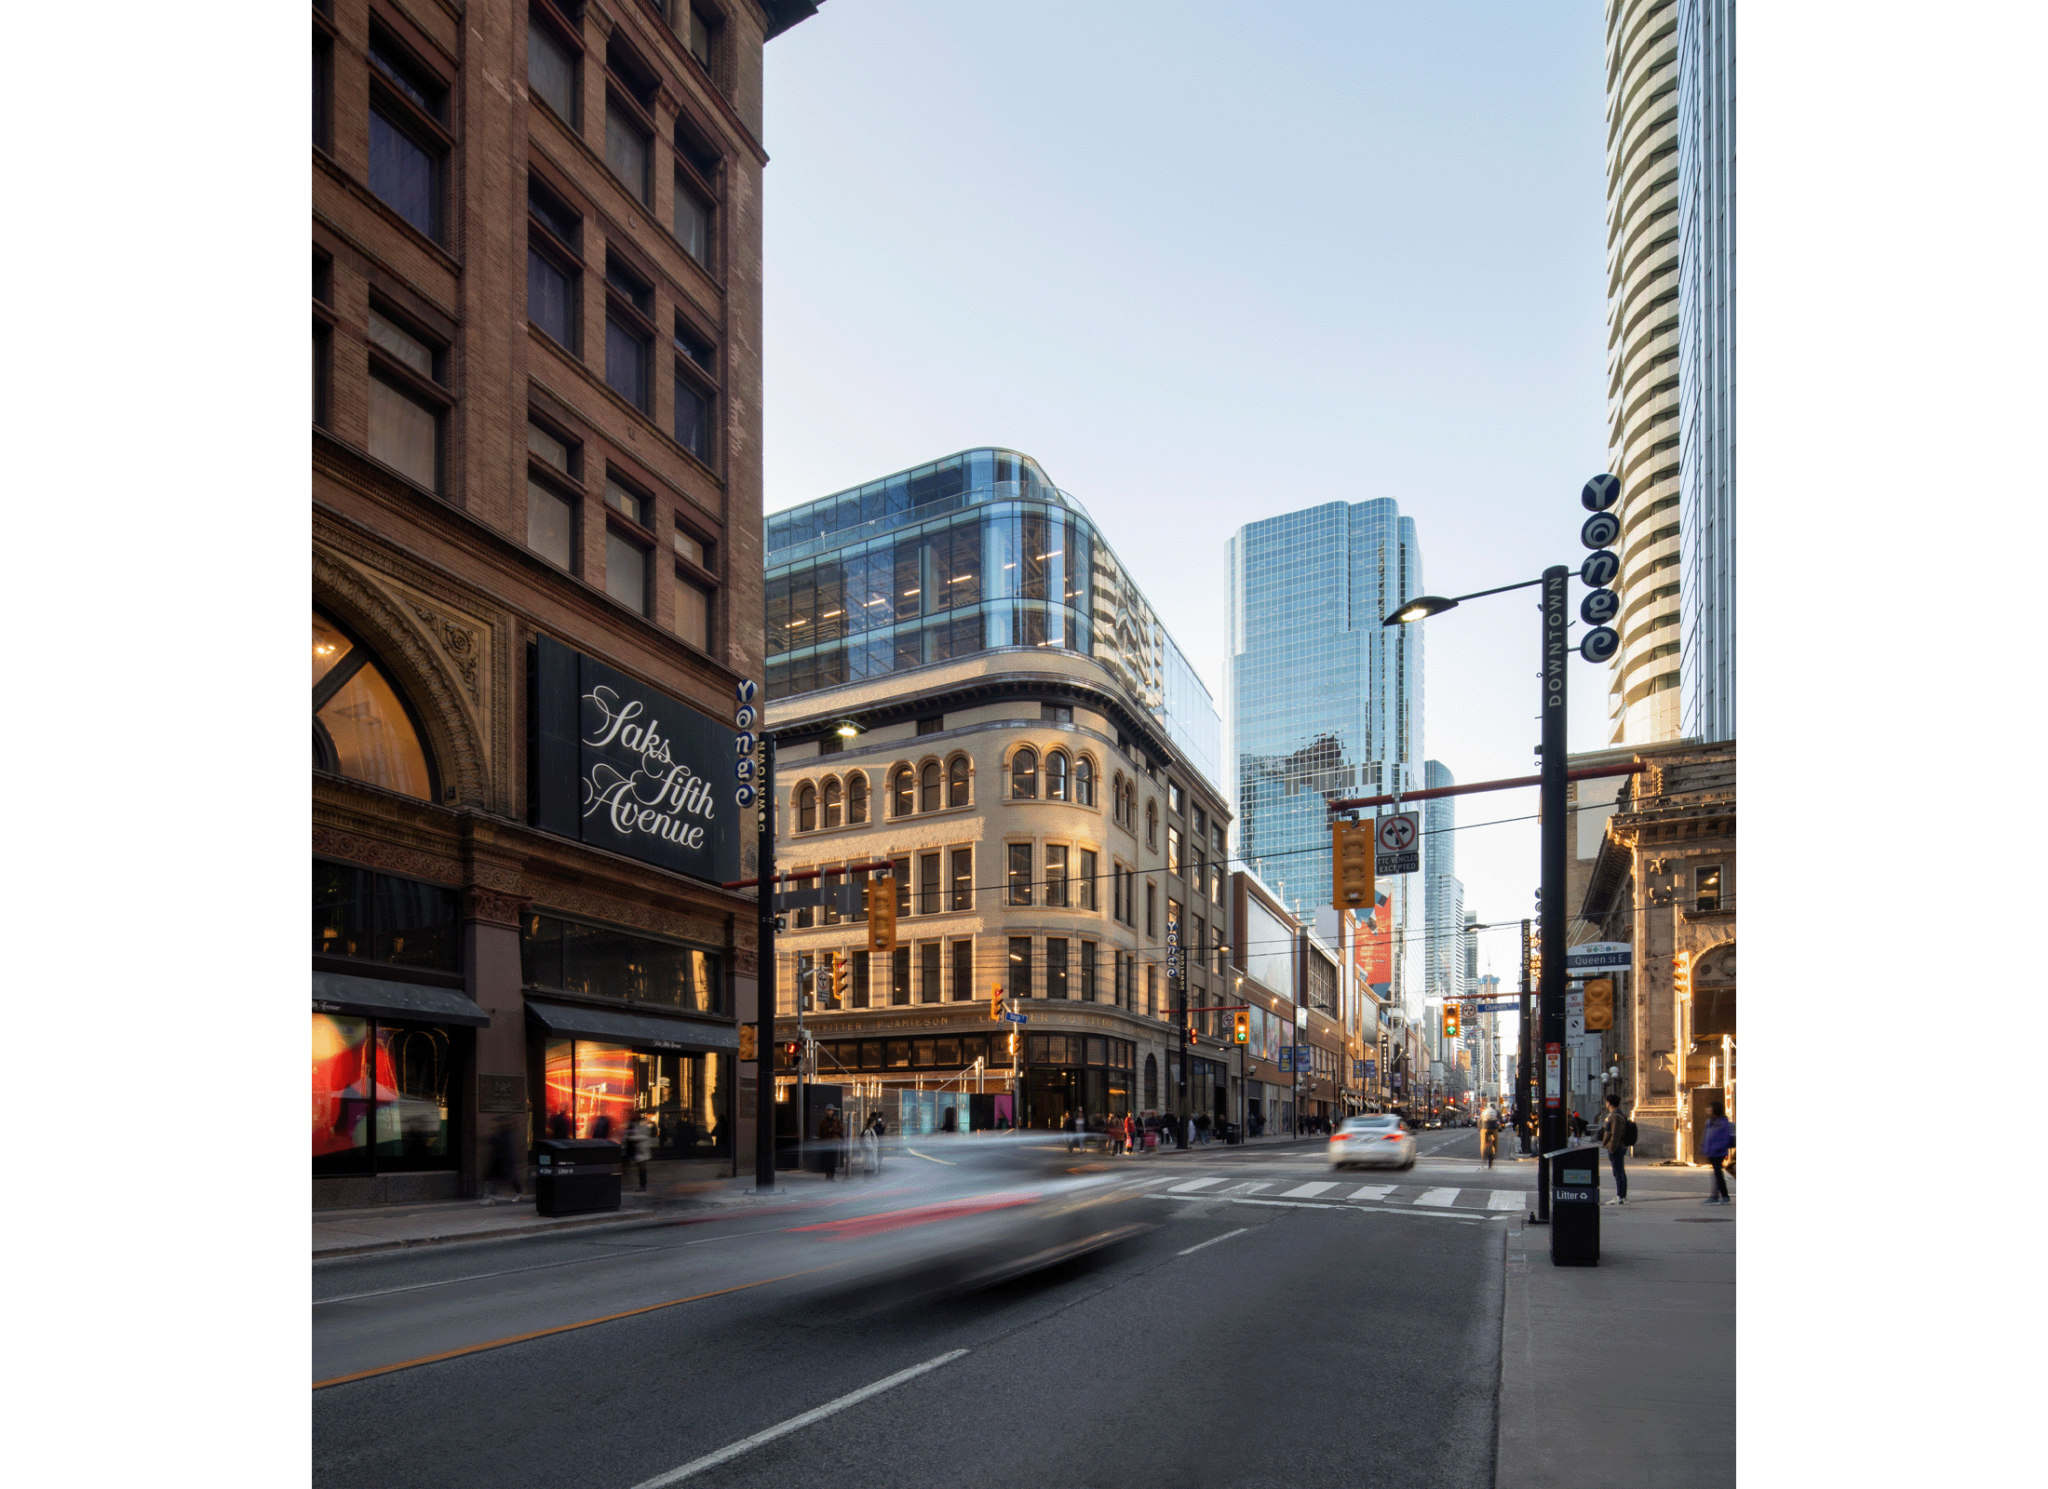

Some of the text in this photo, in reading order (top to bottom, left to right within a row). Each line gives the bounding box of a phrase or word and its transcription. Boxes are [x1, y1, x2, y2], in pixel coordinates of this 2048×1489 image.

[1582, 474, 1620, 662] Yonge
[1549, 576, 1562, 707] DOWNTOWN
[582, 685, 671, 764] Saks
[735, 679, 758, 808] Yonge
[582, 763, 705, 850] Avenue
[634, 757, 715, 821] Fifth
[758, 740, 766, 833] DOWNTOWN
[1379, 863, 1416, 873] EXCEPTED
[1391, 854, 1418, 863] VEHICLES
[1575, 953, 1624, 966] Queen St E
[887, 1017, 948, 1029] JAMIESON
[1556, 1190, 1579, 1200] Litter
